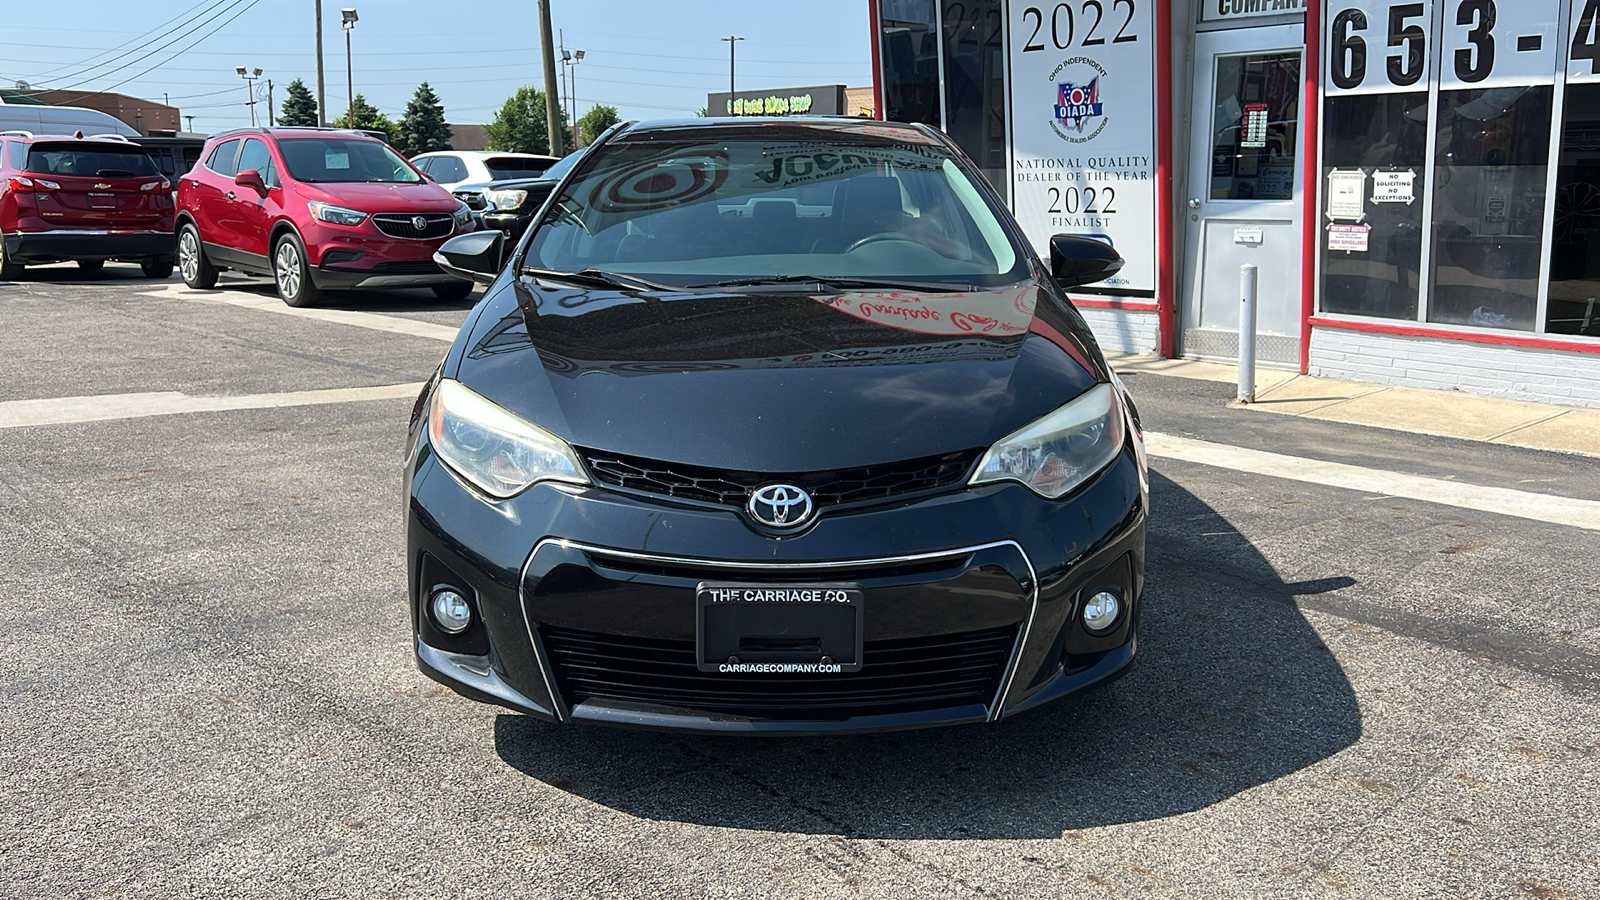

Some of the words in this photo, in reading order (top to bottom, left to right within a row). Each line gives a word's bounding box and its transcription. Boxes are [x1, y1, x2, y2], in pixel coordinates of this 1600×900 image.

[1218, 0, 1307, 16] COMPAN
[1022, 0, 1138, 52] 2022
[1048, 64, 1063, 81] OHIO
[1063, 57, 1107, 77] INDEPENDENT
[1060, 104, 1094, 117] OIADA
[1048, 120, 1069, 142] AUTOMOBILE
[1088, 116, 1109, 141] ASSOCIATION
[1016, 158, 1082, 169] NATIONAL
[1088, 157, 1149, 169] QUALITY
[1018, 172, 1061, 182] DEALER
[1066, 172, 1081, 181] OF
[1086, 172, 1110, 180] THE
[1116, 171, 1148, 180] YEAR
[1048, 187, 1116, 214] 2022
[1052, 218, 1110, 227] FINALIST
[710, 589, 740, 602] THE
[744, 590, 821, 602] CARRIAGE
[825, 590, 851, 603] CO.
[719, 664, 841, 673] CARRIAGECOMPANY.COM
